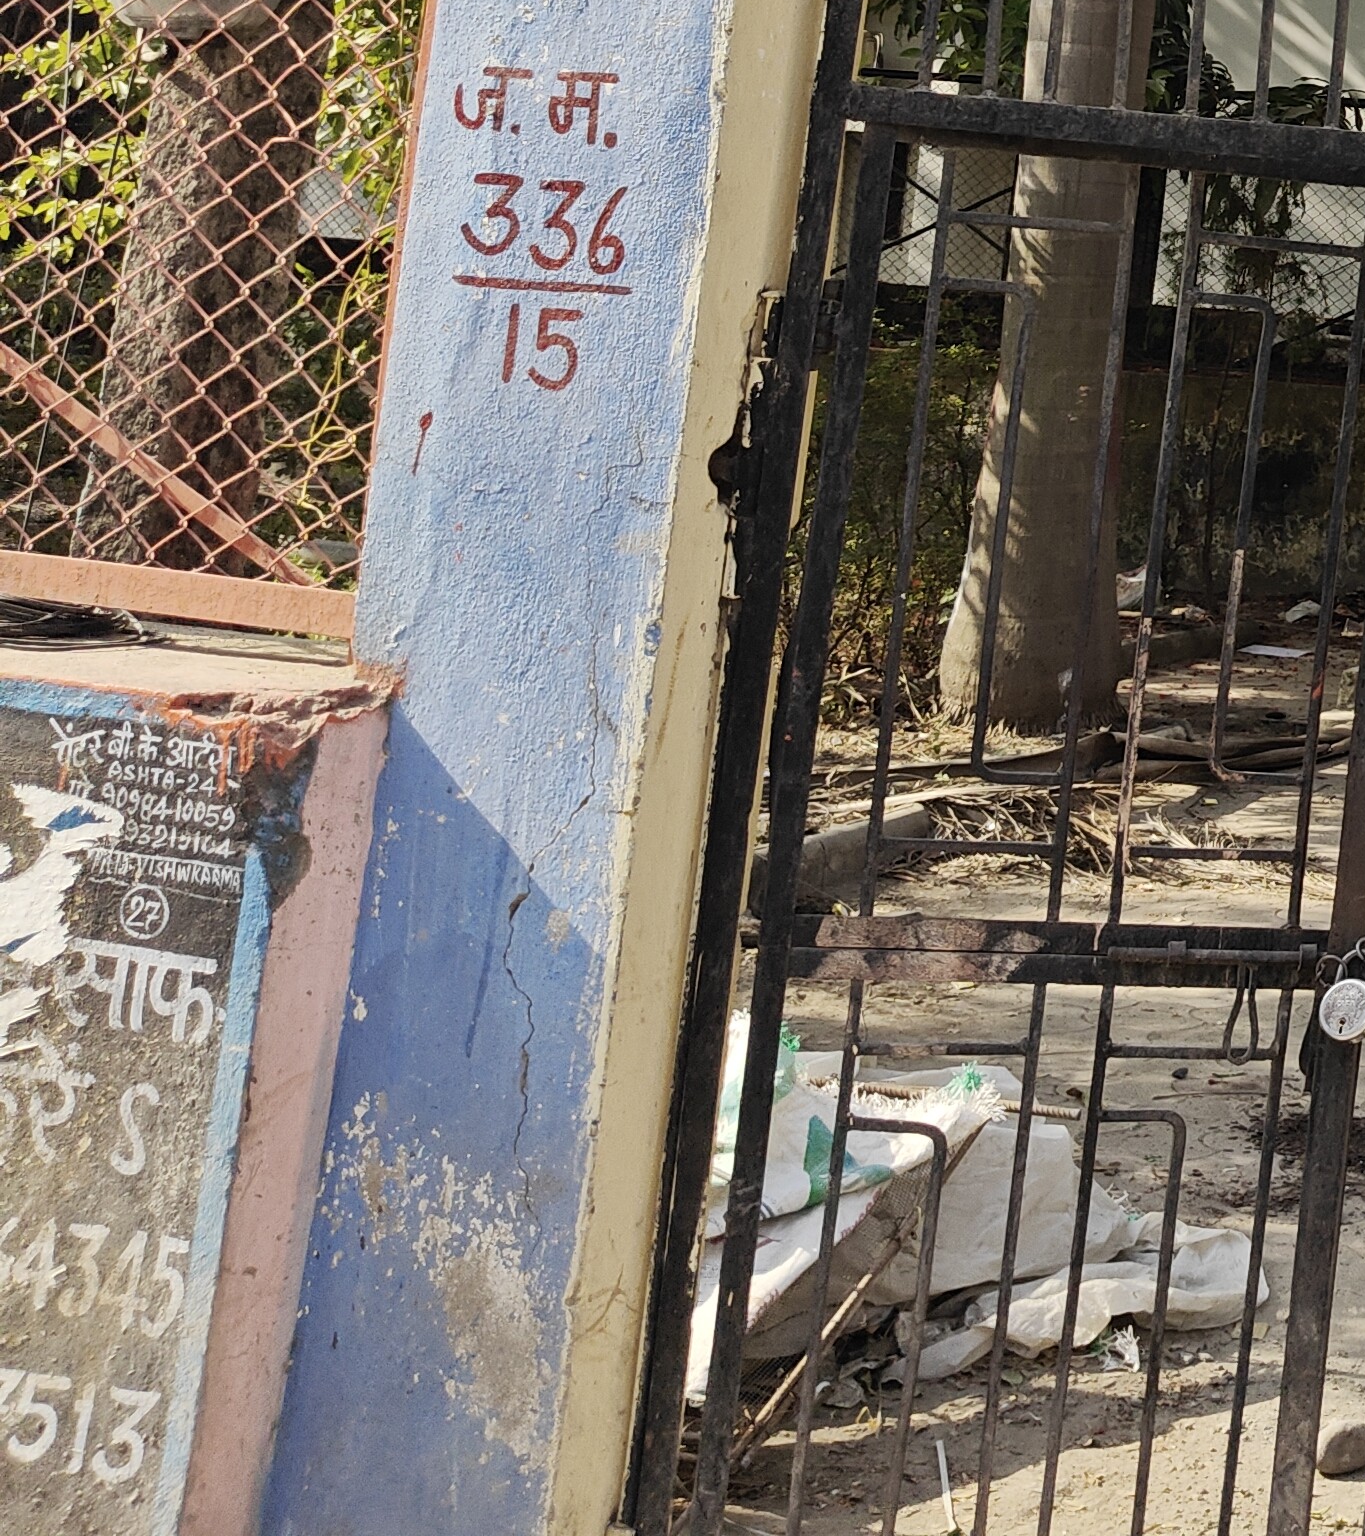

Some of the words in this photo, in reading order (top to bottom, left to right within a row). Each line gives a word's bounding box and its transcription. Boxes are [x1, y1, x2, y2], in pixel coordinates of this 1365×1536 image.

[459, 171, 629, 276] 336
[501, 302, 584, 392] 15
[126, 895, 161, 932] 27
